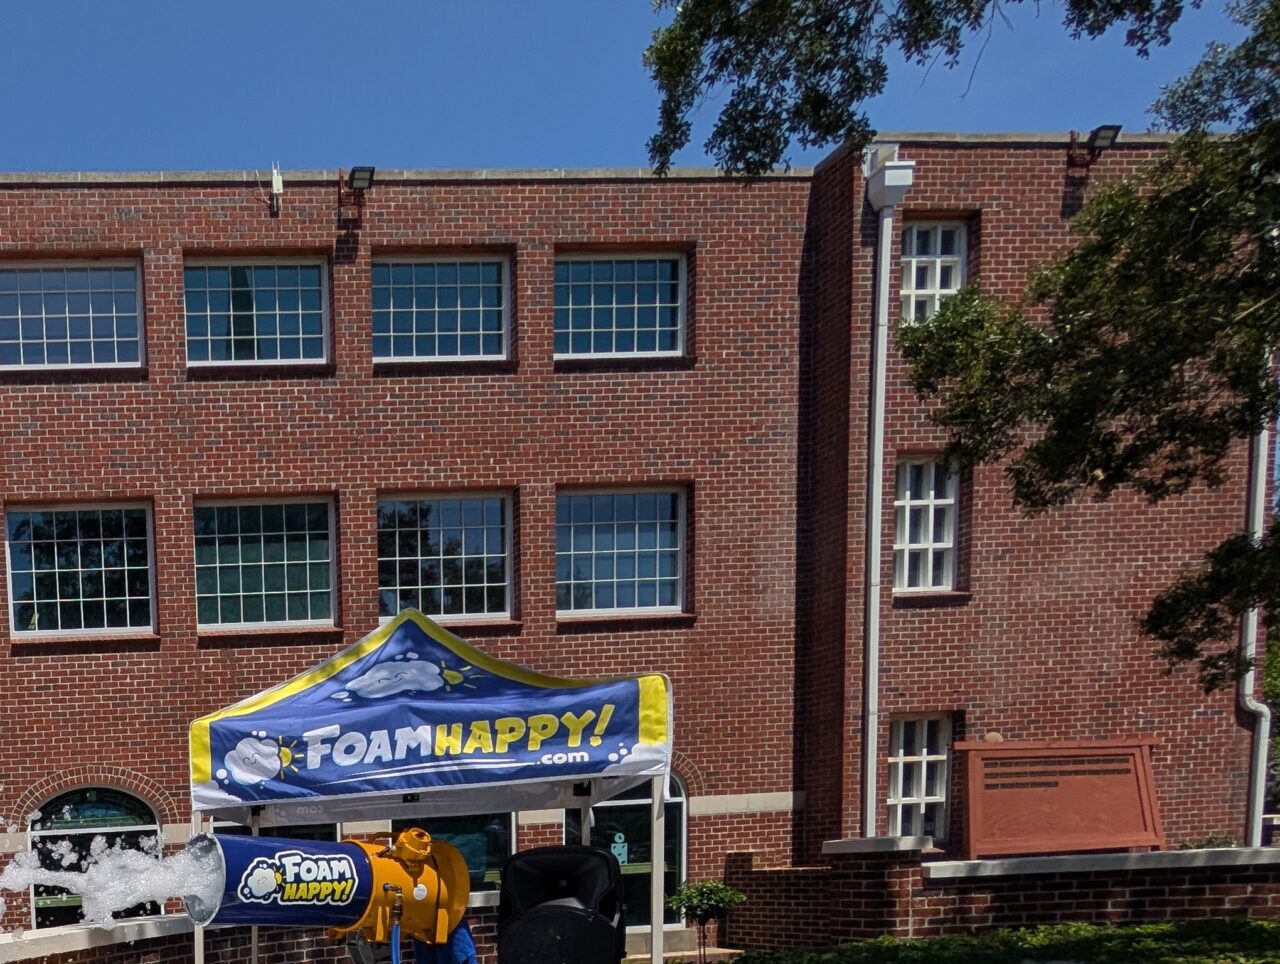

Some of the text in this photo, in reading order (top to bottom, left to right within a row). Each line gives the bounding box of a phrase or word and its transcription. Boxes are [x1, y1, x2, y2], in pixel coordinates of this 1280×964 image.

[536, 750, 590, 766] .com
[282, 856, 351, 882] FOAM
[284, 879, 353, 900] HAPPY!
